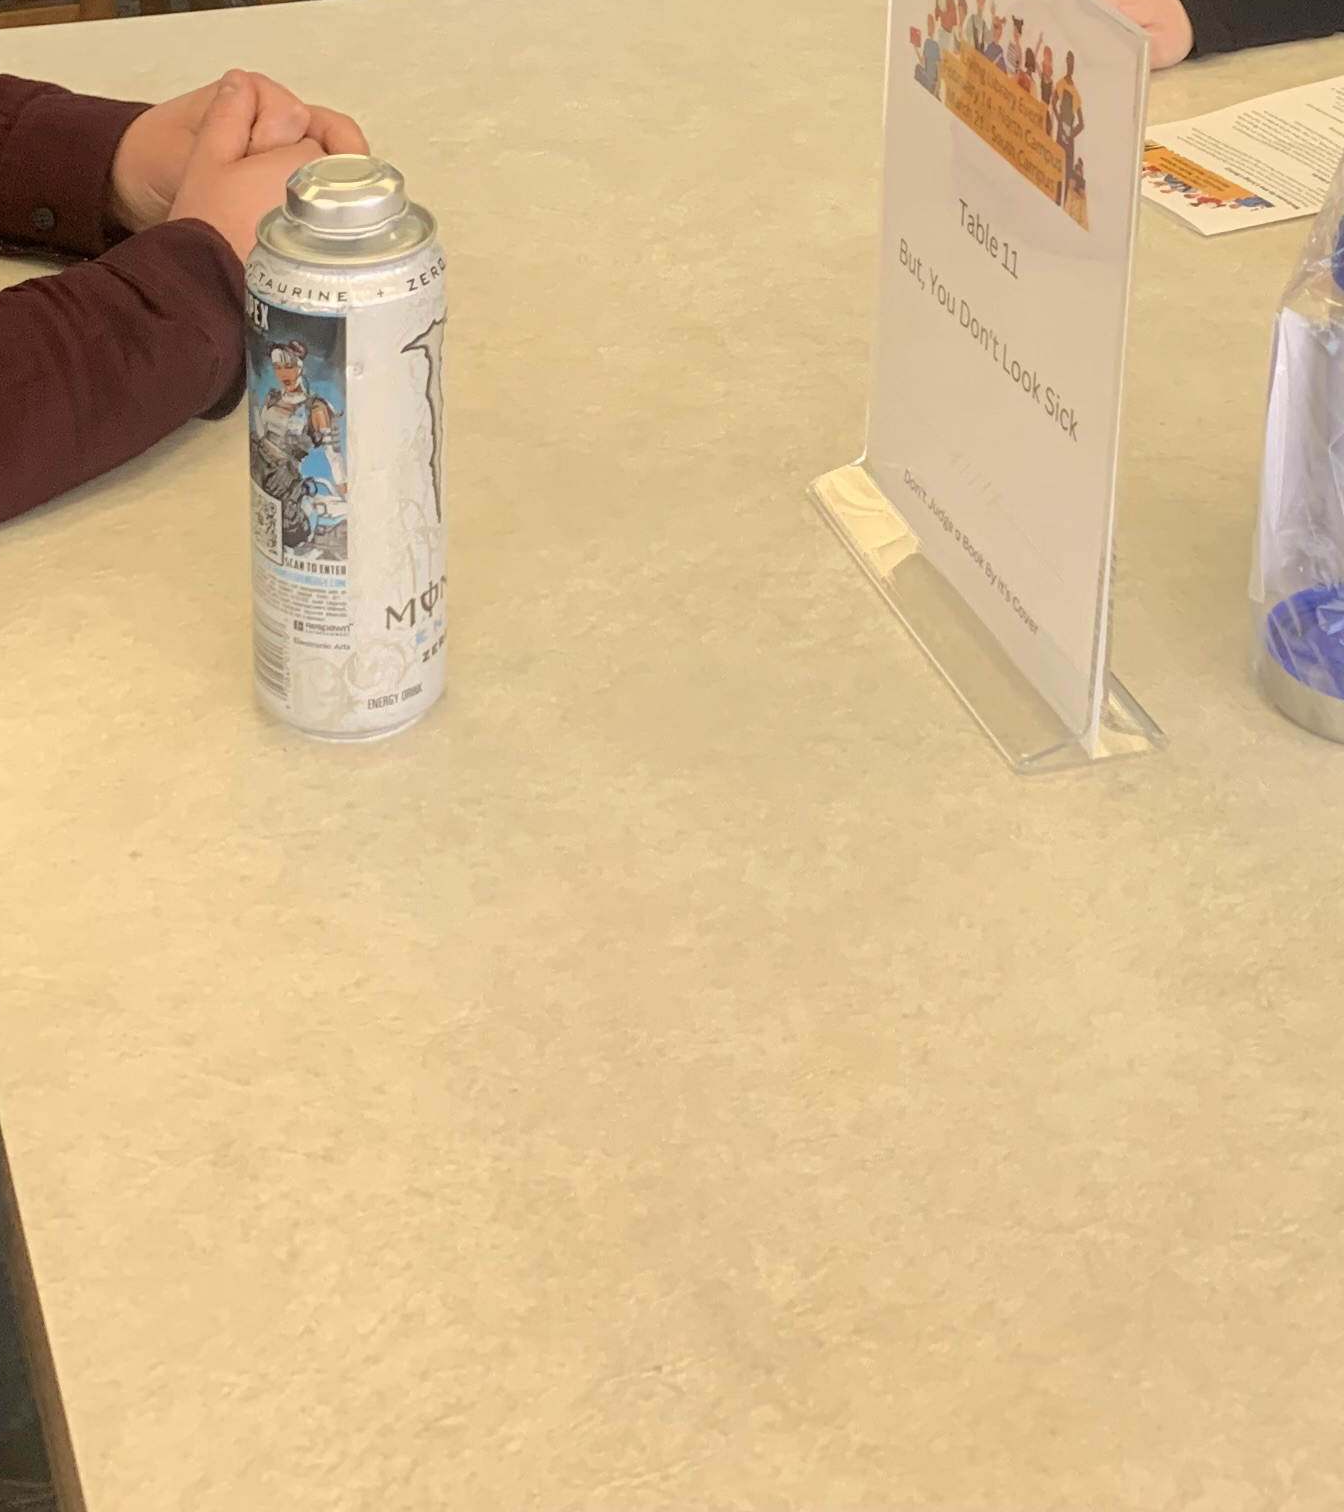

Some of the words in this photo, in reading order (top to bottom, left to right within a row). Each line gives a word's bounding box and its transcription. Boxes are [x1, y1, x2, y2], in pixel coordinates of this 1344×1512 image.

[1017, 148, 1055, 193] Campus
[1024, 128, 1062, 173] Campus
[958, 199, 998, 259] Table
[1002, 242, 1019, 280] 11
[258, 272, 347, 300] TAURINE
[899, 238, 926, 291] But,
[929, 267, 956, 316] You
[959, 299, 999, 363] Don't
[1002, 344, 1040, 405] Look
[1044, 386, 1079, 443] Sick
[286, 559, 304, 572] SCAN
[307, 562, 318, 574] TO
[319, 564, 347, 576] ENTER
[905, 469, 927, 503] Don't
[927, 497, 954, 534] Judge
[962, 534, 986, 571] Book
[1012, 595, 1040, 636] Cover
[367, 693, 399, 711] ENERGY
